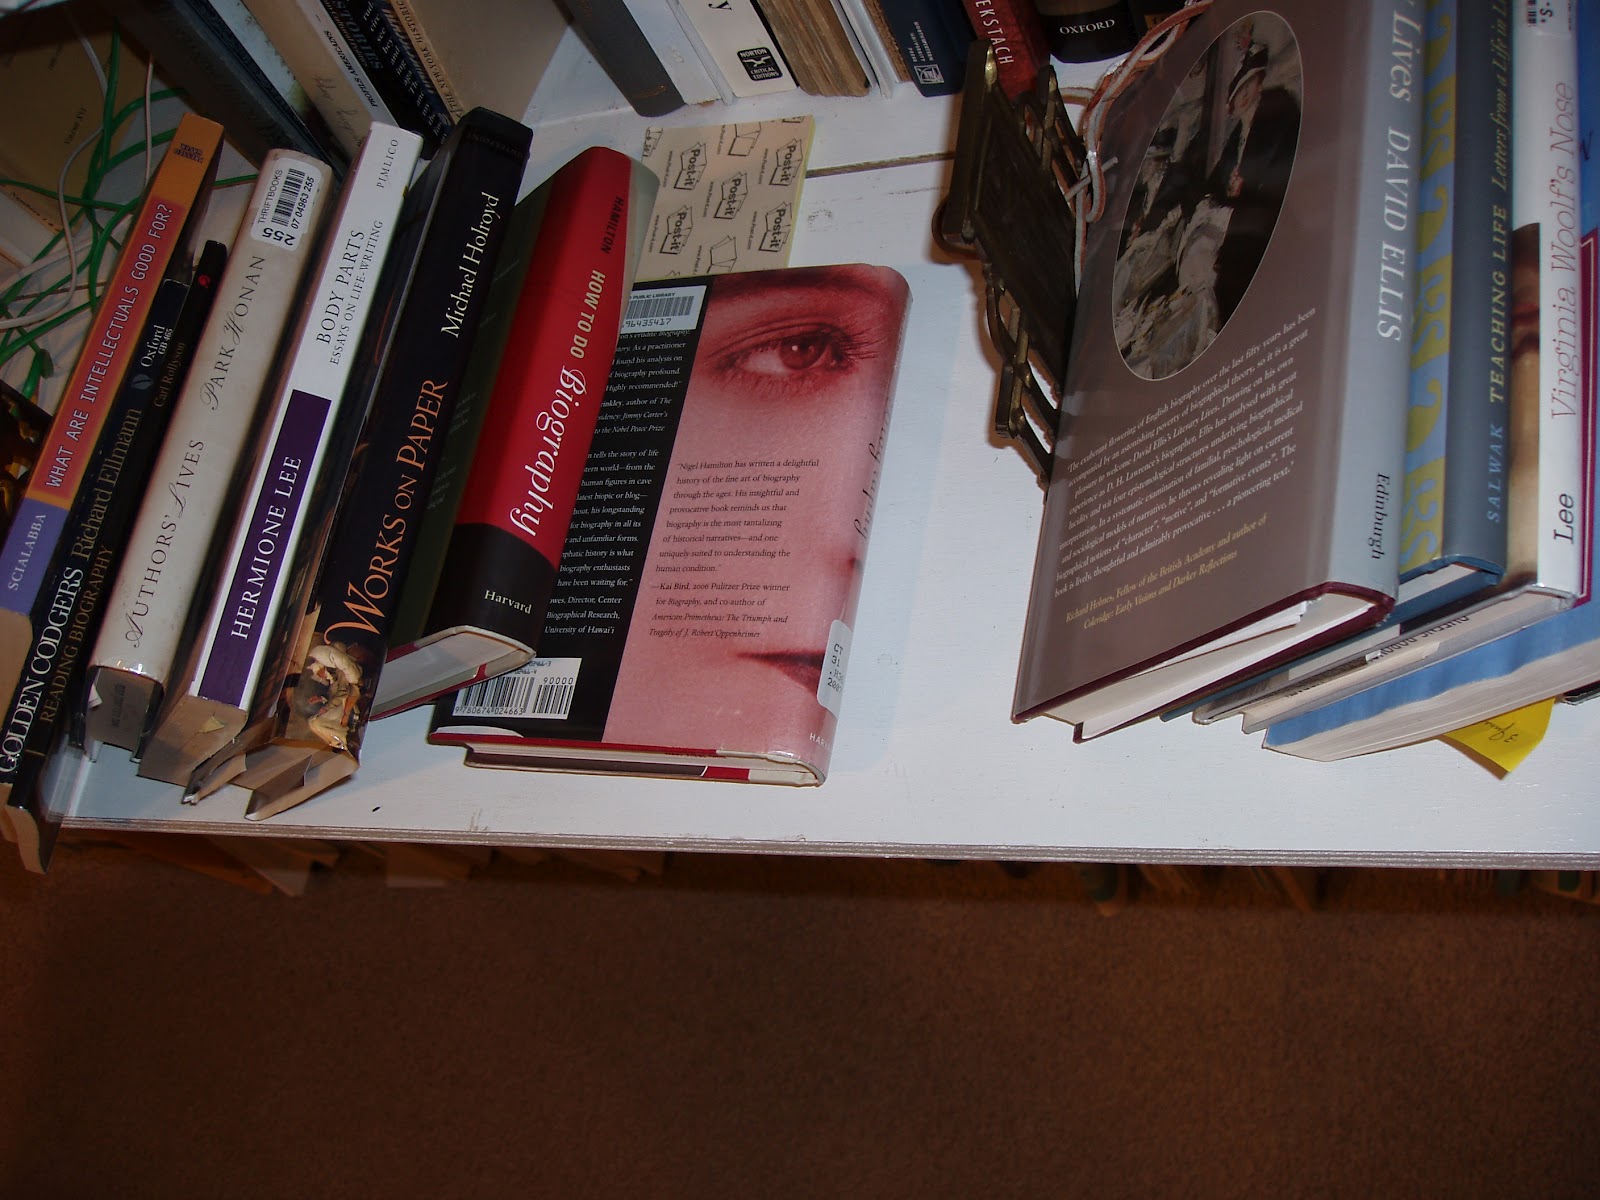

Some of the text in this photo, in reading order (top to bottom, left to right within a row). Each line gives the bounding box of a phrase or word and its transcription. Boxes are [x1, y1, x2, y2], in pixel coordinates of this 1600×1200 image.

[1059, 19, 1116, 35] OXFORD
[739, 48, 768, 58] NORTON
[750, 66, 775, 75] CRITICAL
[752, 71, 780, 80] EDITIONS
[445, 92, 458, 109] THE
[376, 138, 400, 189] PIMLICO
[684, 148, 701, 187] Post-it
[780, 145, 797, 182] Post-it
[1377, 10, 1422, 341] Lives DAVID ELLIS
[1491, 130, 1510, 192] Letters
[258, 169, 283, 224] THRIFTBOOKS
[291, 176, 315, 229] 07 04963 255
[724, 178, 742, 216] Post-it
[262, 227, 296, 246] 255
[600, 195, 625, 255] HAMILTON
[670, 211, 687, 251] Post-it
[769, 208, 786, 248] Post-it
[440, 267, 478, 338] Michael
[463, 192, 502, 277] Holroyd
[1549, 82, 1580, 421] Virginia Woolf's Nose
[223, 254, 266, 345] HONAN
[315, 229, 366, 345] BODY PARTS
[330, 220, 384, 365] ESSAYS ON LIFE-WRITING
[1489, 204, 1509, 403] TEACHING LIFE
[46, 204, 173, 487] WHAT ARE INTELLECTUALS GOOD FOR?
[140, 325, 166, 368] Oxford
[621, 318, 672, 328] 96435417
[153, 342, 185, 408] Carl Rollyson
[396, 378, 448, 471] PAPER
[510, 269, 606, 538] HOW TO DO Biography
[72, 408, 142, 560] Richard Ellmann
[677, 477, 700, 485] history
[763, 474, 800, 483] biography
[700, 461, 732, 469] Hamilton
[783, 459, 819, 468] delightful
[1486, 424, 1504, 523] SALWAK
[393, 474, 416, 511] ON
[674, 491, 701, 500] through
[703, 490, 714, 498] the
[749, 489, 783, 498] insightful
[1370, 473, 1390, 560] Edinburgh
[1553, 493, 1574, 544] Lee
[8, 513, 46, 591] SCIALABBA
[231, 455, 303, 641] HERMIONE LEE
[1066, 602, 1089, 623] Richard
[1116, 584, 1136, 598] Fellow
[1138, 577, 1146, 587] of
[1147, 573, 1158, 583] the
[1160, 560, 1182, 578] British
[1184, 544, 1216, 565] Academy
[1217, 533, 1231, 548] and
[1232, 522, 1256, 540] author
[1257, 512, 1268, 529] of
[324, 513, 407, 645] WORKS
[484, 589, 533, 615] Harvard
[598, 596, 622, 604] Center
[1116, 599, 1133, 616] Early
[1159, 581, 1172, 596] and
[1173, 571, 1197, 588] Darker
[1199, 550, 1237, 575] Reflections
[40, 543, 113, 724] READING BIOGRAPHY
[545, 626, 577, 635] University
[547, 611, 620, 620] Biographical Research,
[0, 566, 84, 774] GOLDEN CODGERS
[832, 656, 841, 668] 31
[834, 643, 844, 655] CT
[543, 677, 573, 685] 90000
